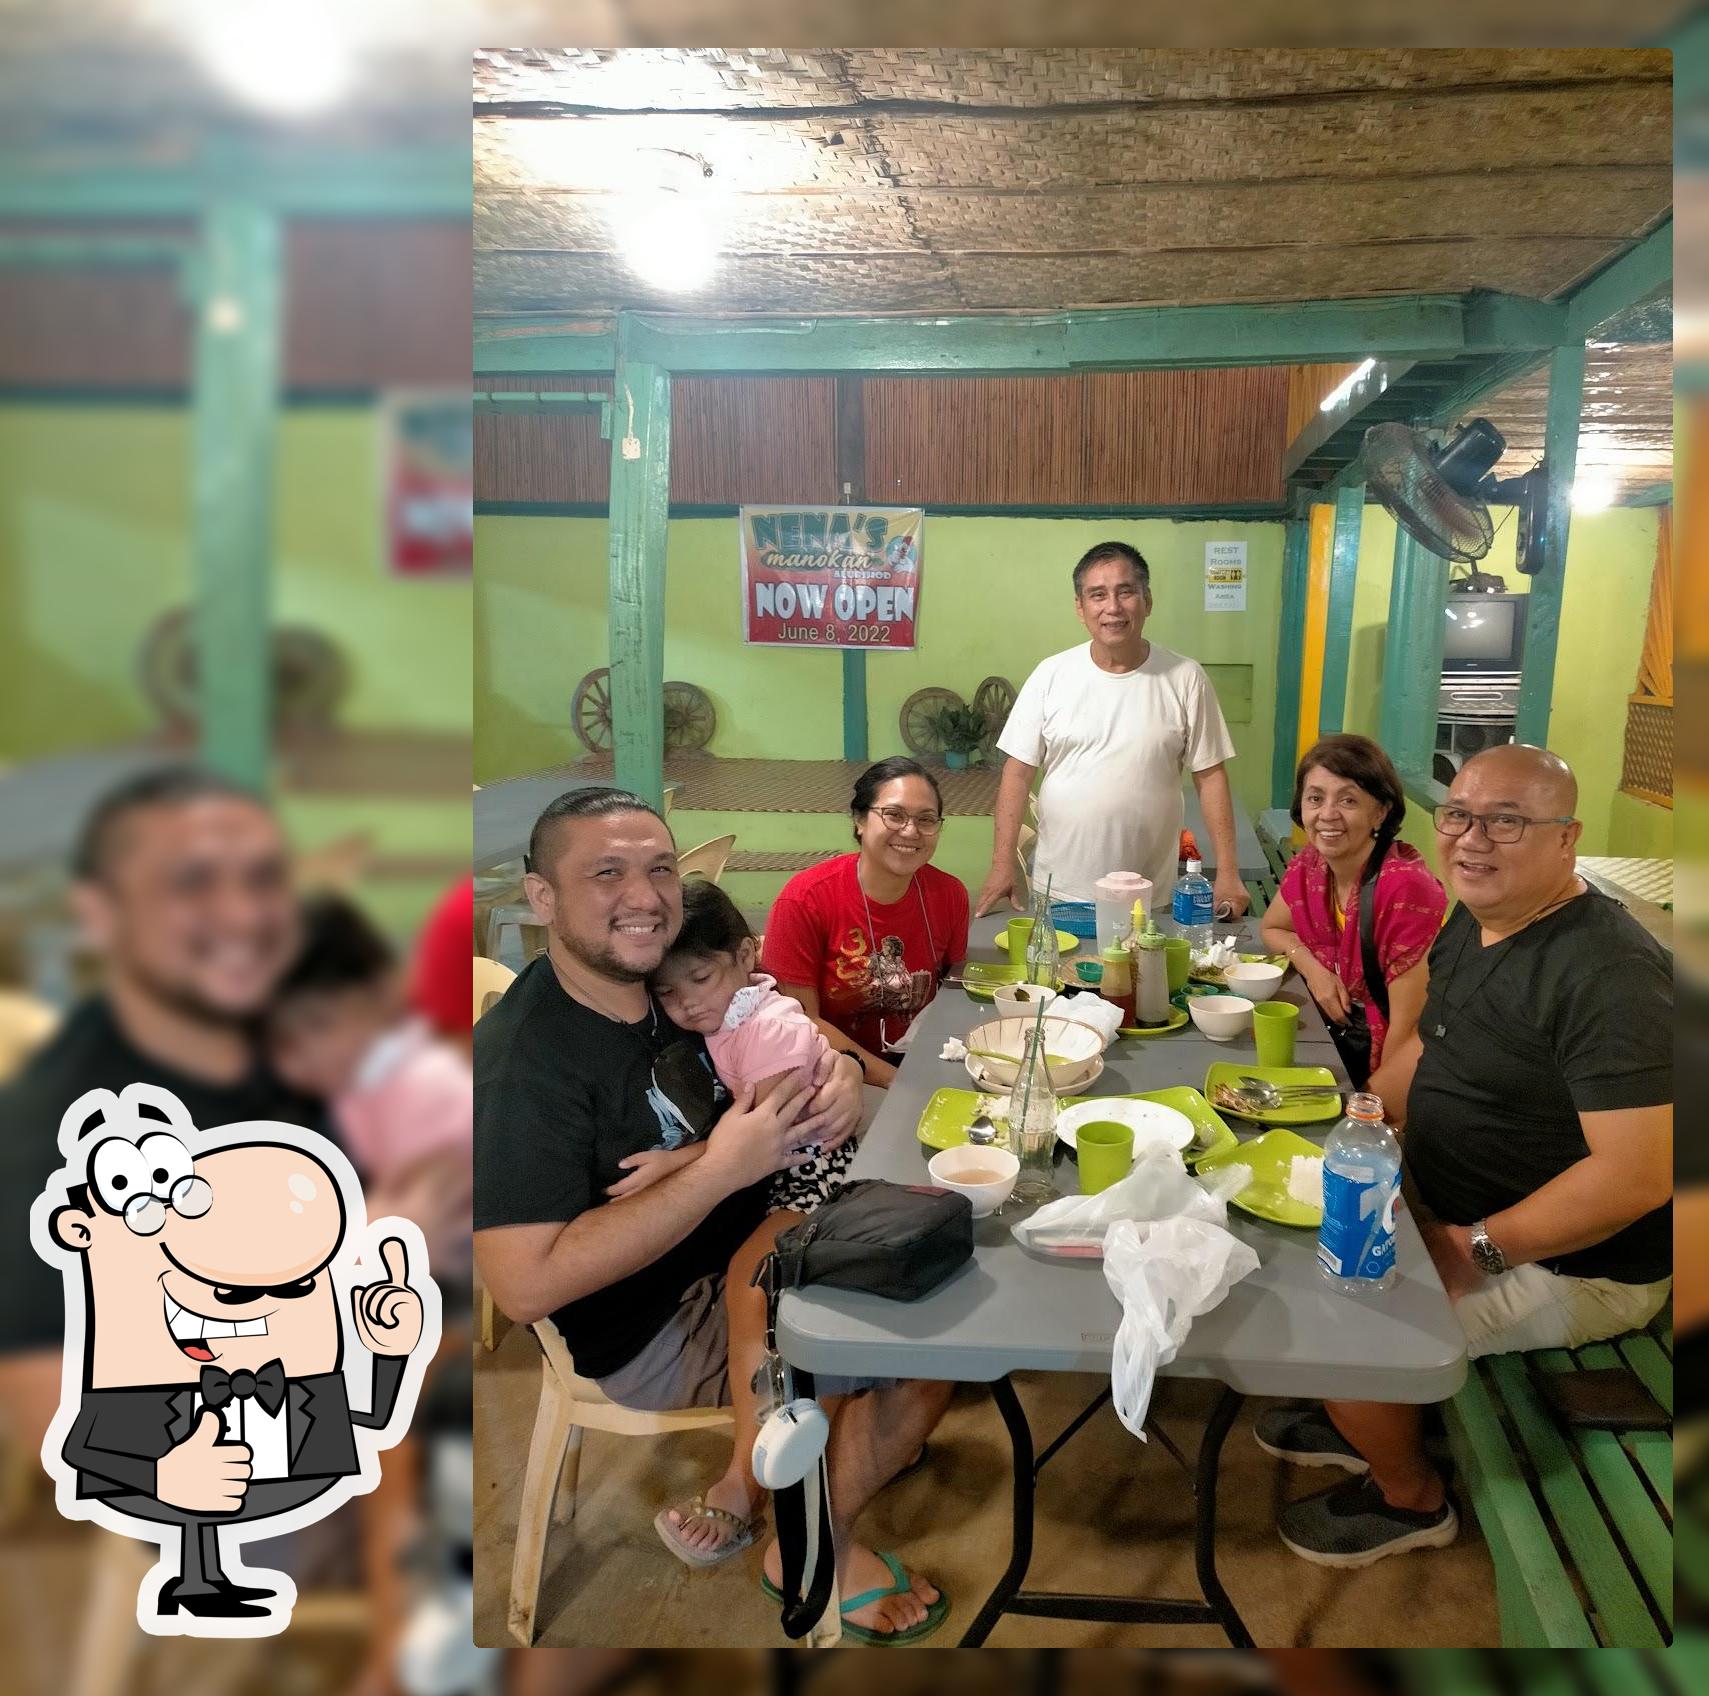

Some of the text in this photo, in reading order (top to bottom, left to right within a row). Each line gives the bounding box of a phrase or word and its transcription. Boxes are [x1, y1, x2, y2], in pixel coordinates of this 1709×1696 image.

[751, 511, 888, 552] NENA'S
[766, 549, 873, 571] manokan
[1213, 546, 1239, 555] REST
[755, 582, 914, 623] NOW OPEN
[778, 623, 890, 643] June 8, 2022
